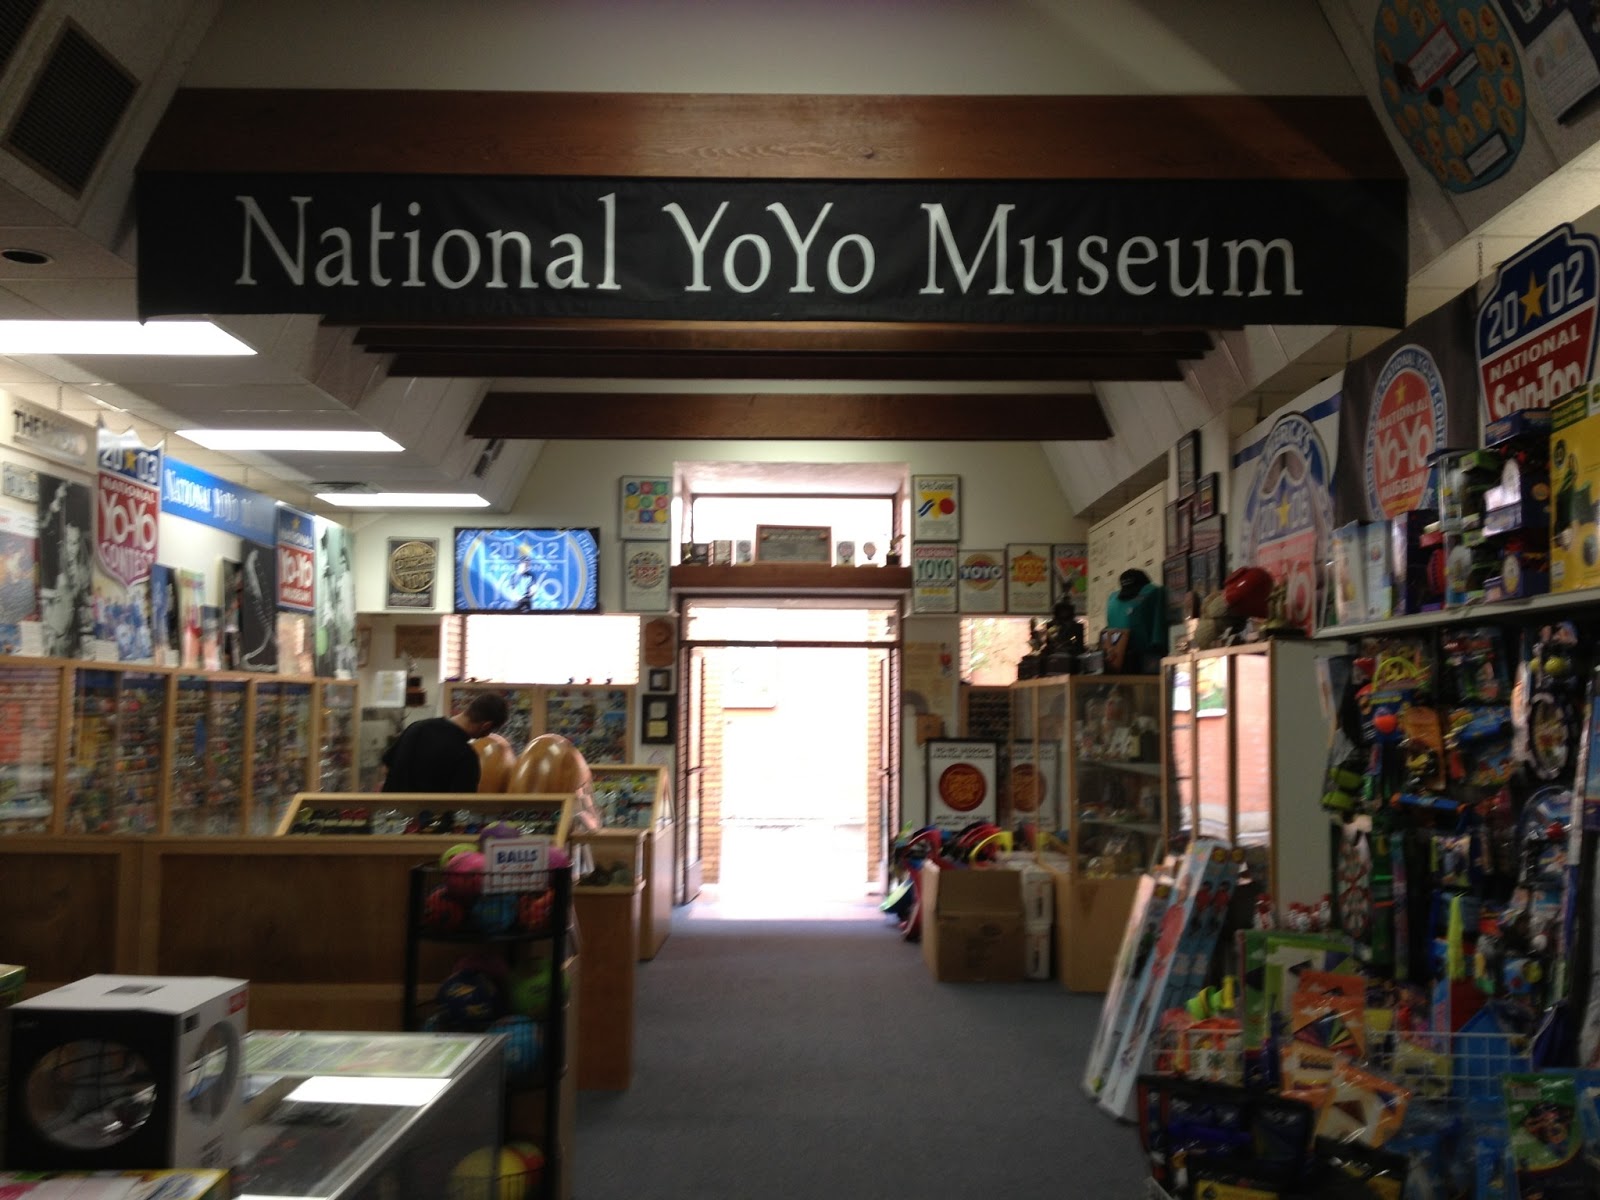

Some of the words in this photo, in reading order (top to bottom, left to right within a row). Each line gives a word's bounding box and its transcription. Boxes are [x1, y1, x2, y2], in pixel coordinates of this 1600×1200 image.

[235, 192, 622, 291] National
[661, 201, 876, 293] YoYo
[919, 202, 1303, 297] Museum
[1489, 323, 1581, 384] NATIONAL
[1377, 397, 1430, 432] NATIONAL
[1375, 415, 1433, 482] Yo-Yo
[102, 475, 156, 504] NATIONAL
[1381, 471, 1427, 499] MUSEUM
[99, 487, 157, 552] Yo-Yo
[102, 542, 154, 579] CONTEST
[916, 559, 954, 580] YOYO
[960, 563, 1004, 580] YOYO
[497, 850, 538, 864] BALLS
